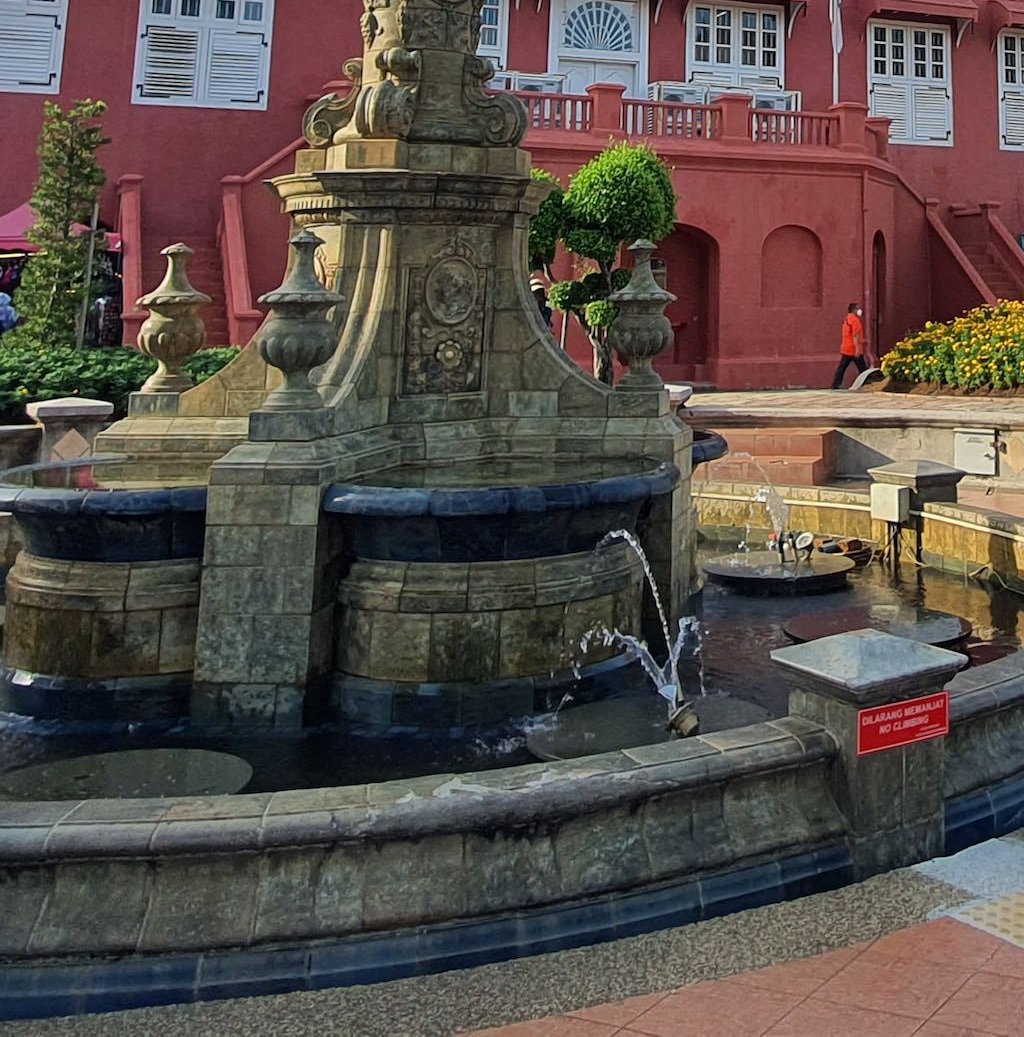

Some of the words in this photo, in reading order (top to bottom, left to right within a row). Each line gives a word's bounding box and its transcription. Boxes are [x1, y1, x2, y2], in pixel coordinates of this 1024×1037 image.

[863, 709, 902, 726] DILARANG
[904, 699, 944, 716] MEMANJAT
[879, 723, 892, 735] NO
[893, 715, 929, 731] CLIMBING
